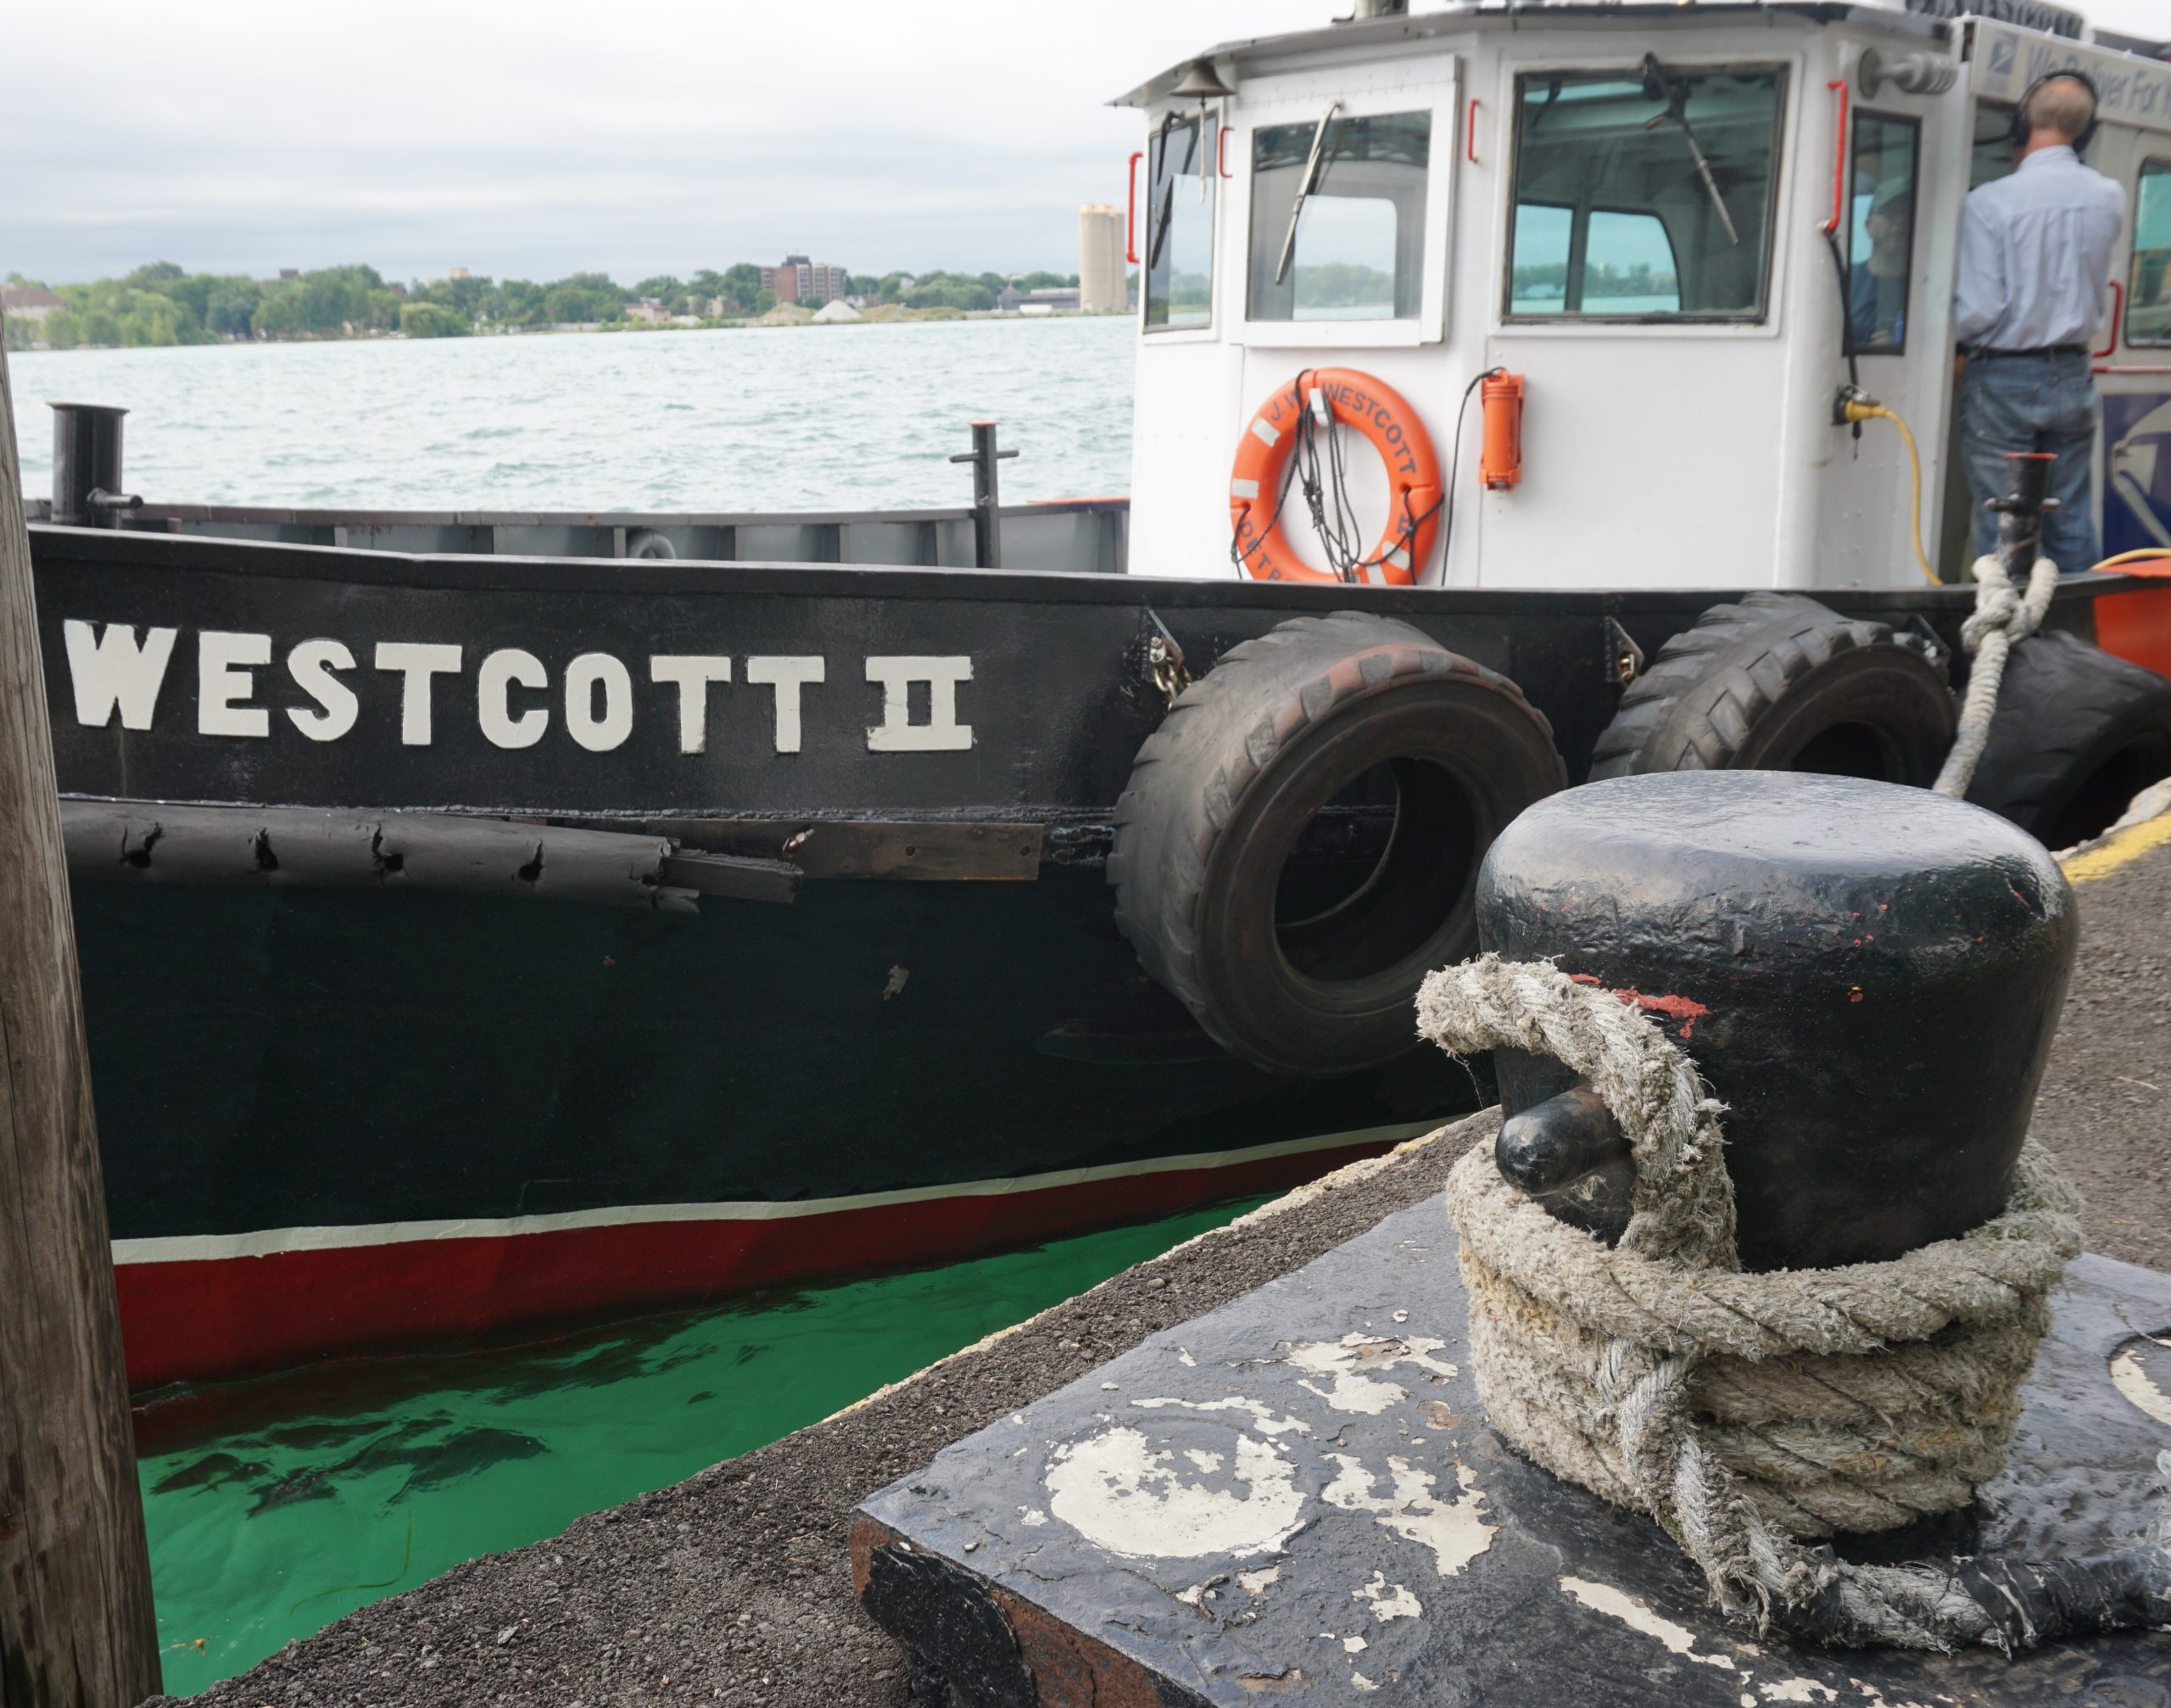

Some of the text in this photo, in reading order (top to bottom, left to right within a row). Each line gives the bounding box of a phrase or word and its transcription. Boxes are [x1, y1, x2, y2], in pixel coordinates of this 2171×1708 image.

[1322, 382, 1417, 475] WESTCOTT
[64, 619, 974, 753] WESTCOTT II
